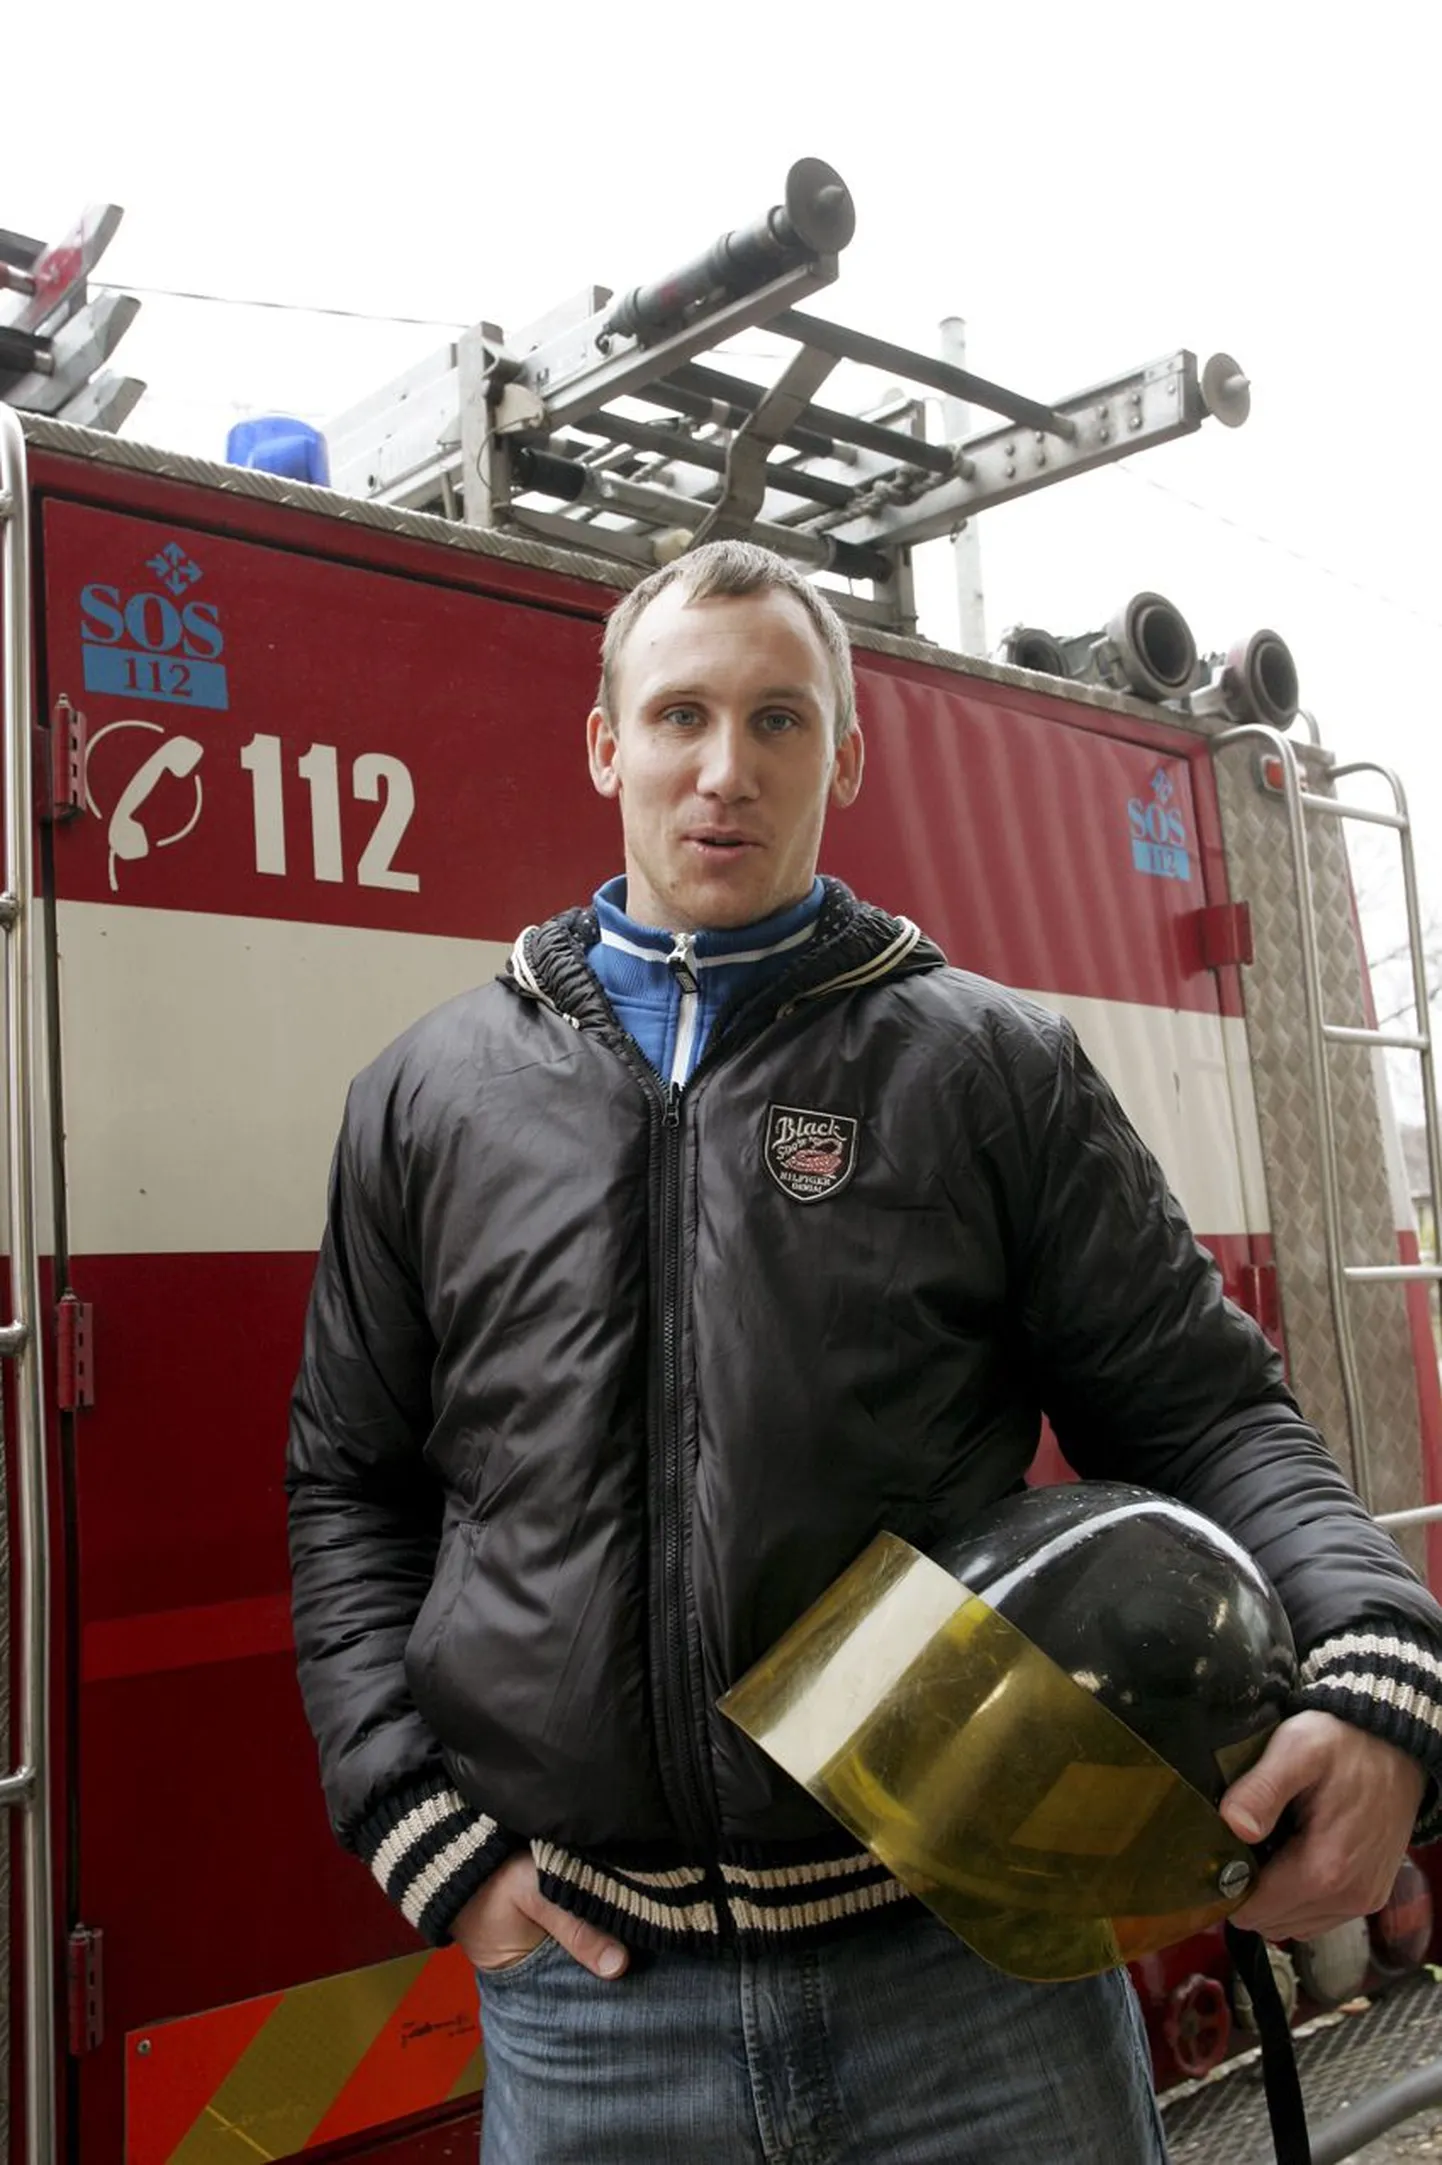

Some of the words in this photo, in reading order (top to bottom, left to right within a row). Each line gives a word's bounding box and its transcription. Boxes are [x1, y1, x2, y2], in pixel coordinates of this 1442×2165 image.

[80, 583, 224, 660] SOS
[122, 657, 194, 697] 112
[240, 732, 420, 893] 112
[1127, 797, 1187, 848] SOS
[772, 1116, 847, 1150] Black
